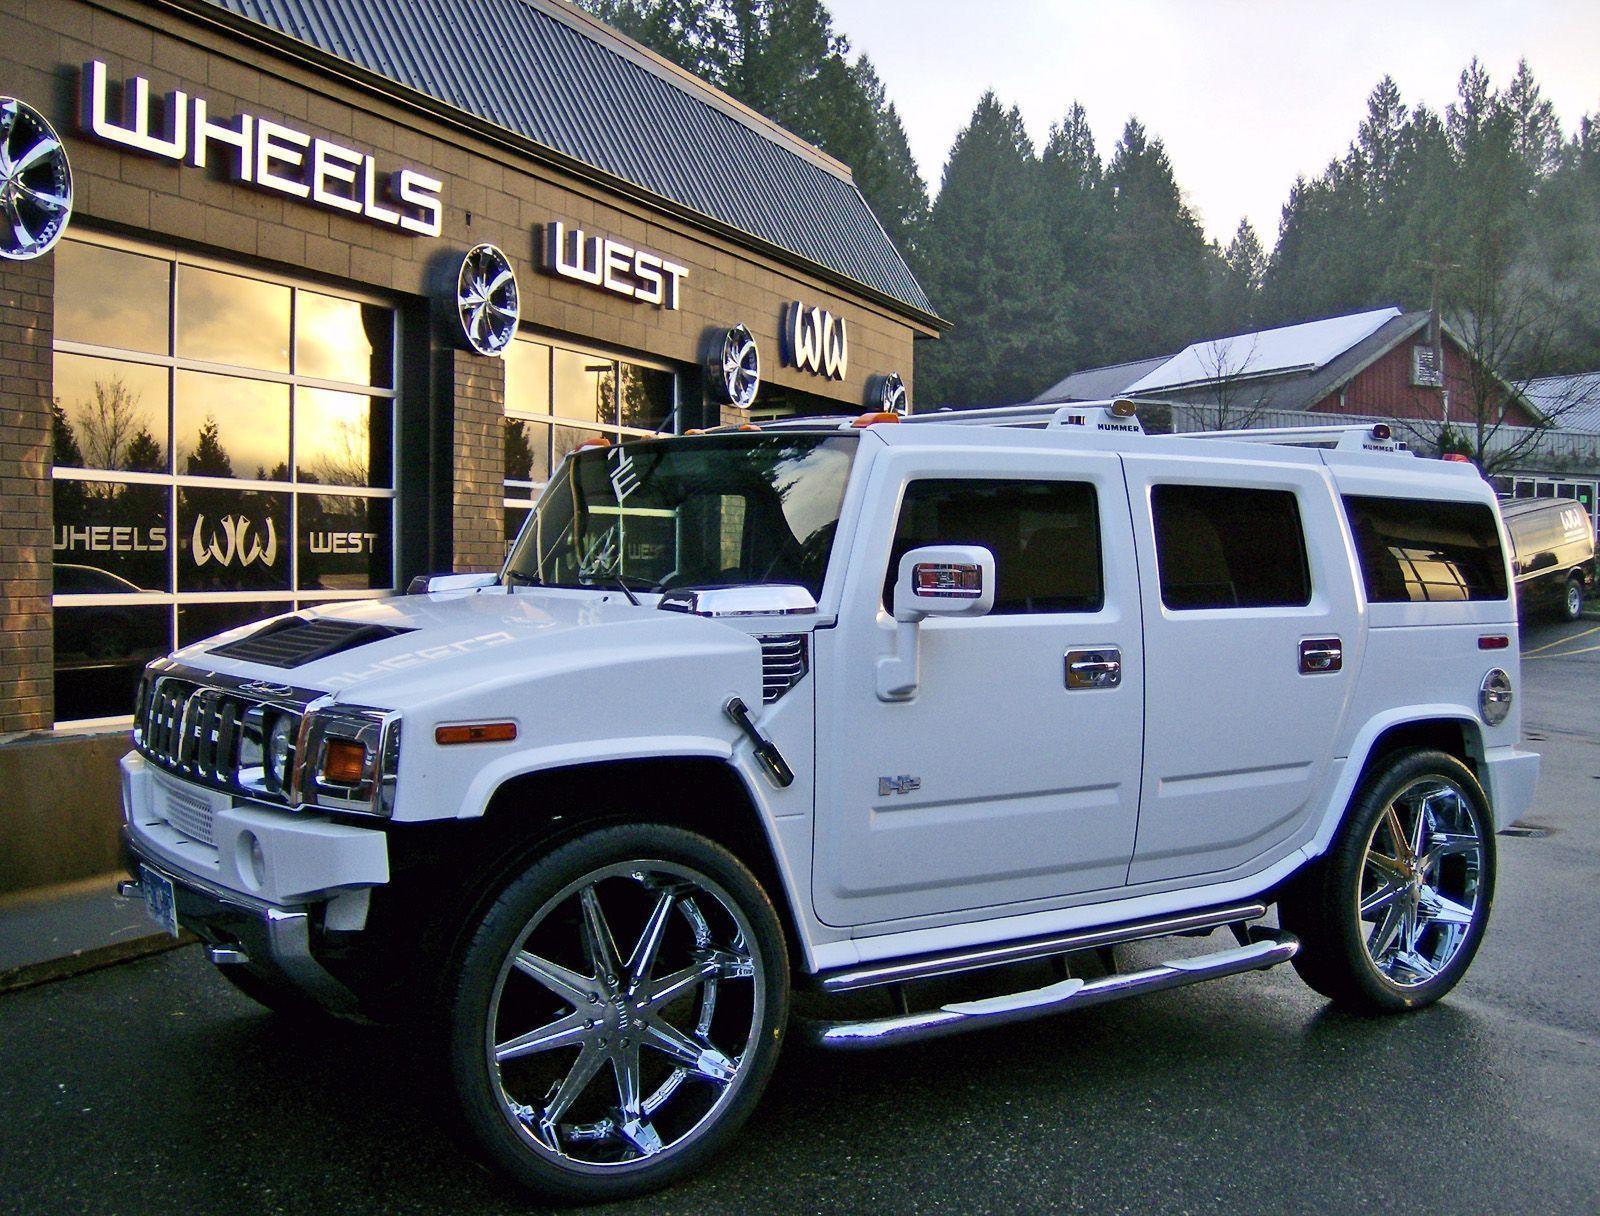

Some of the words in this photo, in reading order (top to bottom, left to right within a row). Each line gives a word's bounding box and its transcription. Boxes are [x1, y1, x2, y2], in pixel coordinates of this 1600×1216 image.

[92, 60, 443, 238] WHEELS
[554, 221, 690, 311] WEST
[1097, 423, 1140, 432] HUMMER
[1362, 443, 1395, 452] HUMMER
[309, 531, 379, 553] WEST
